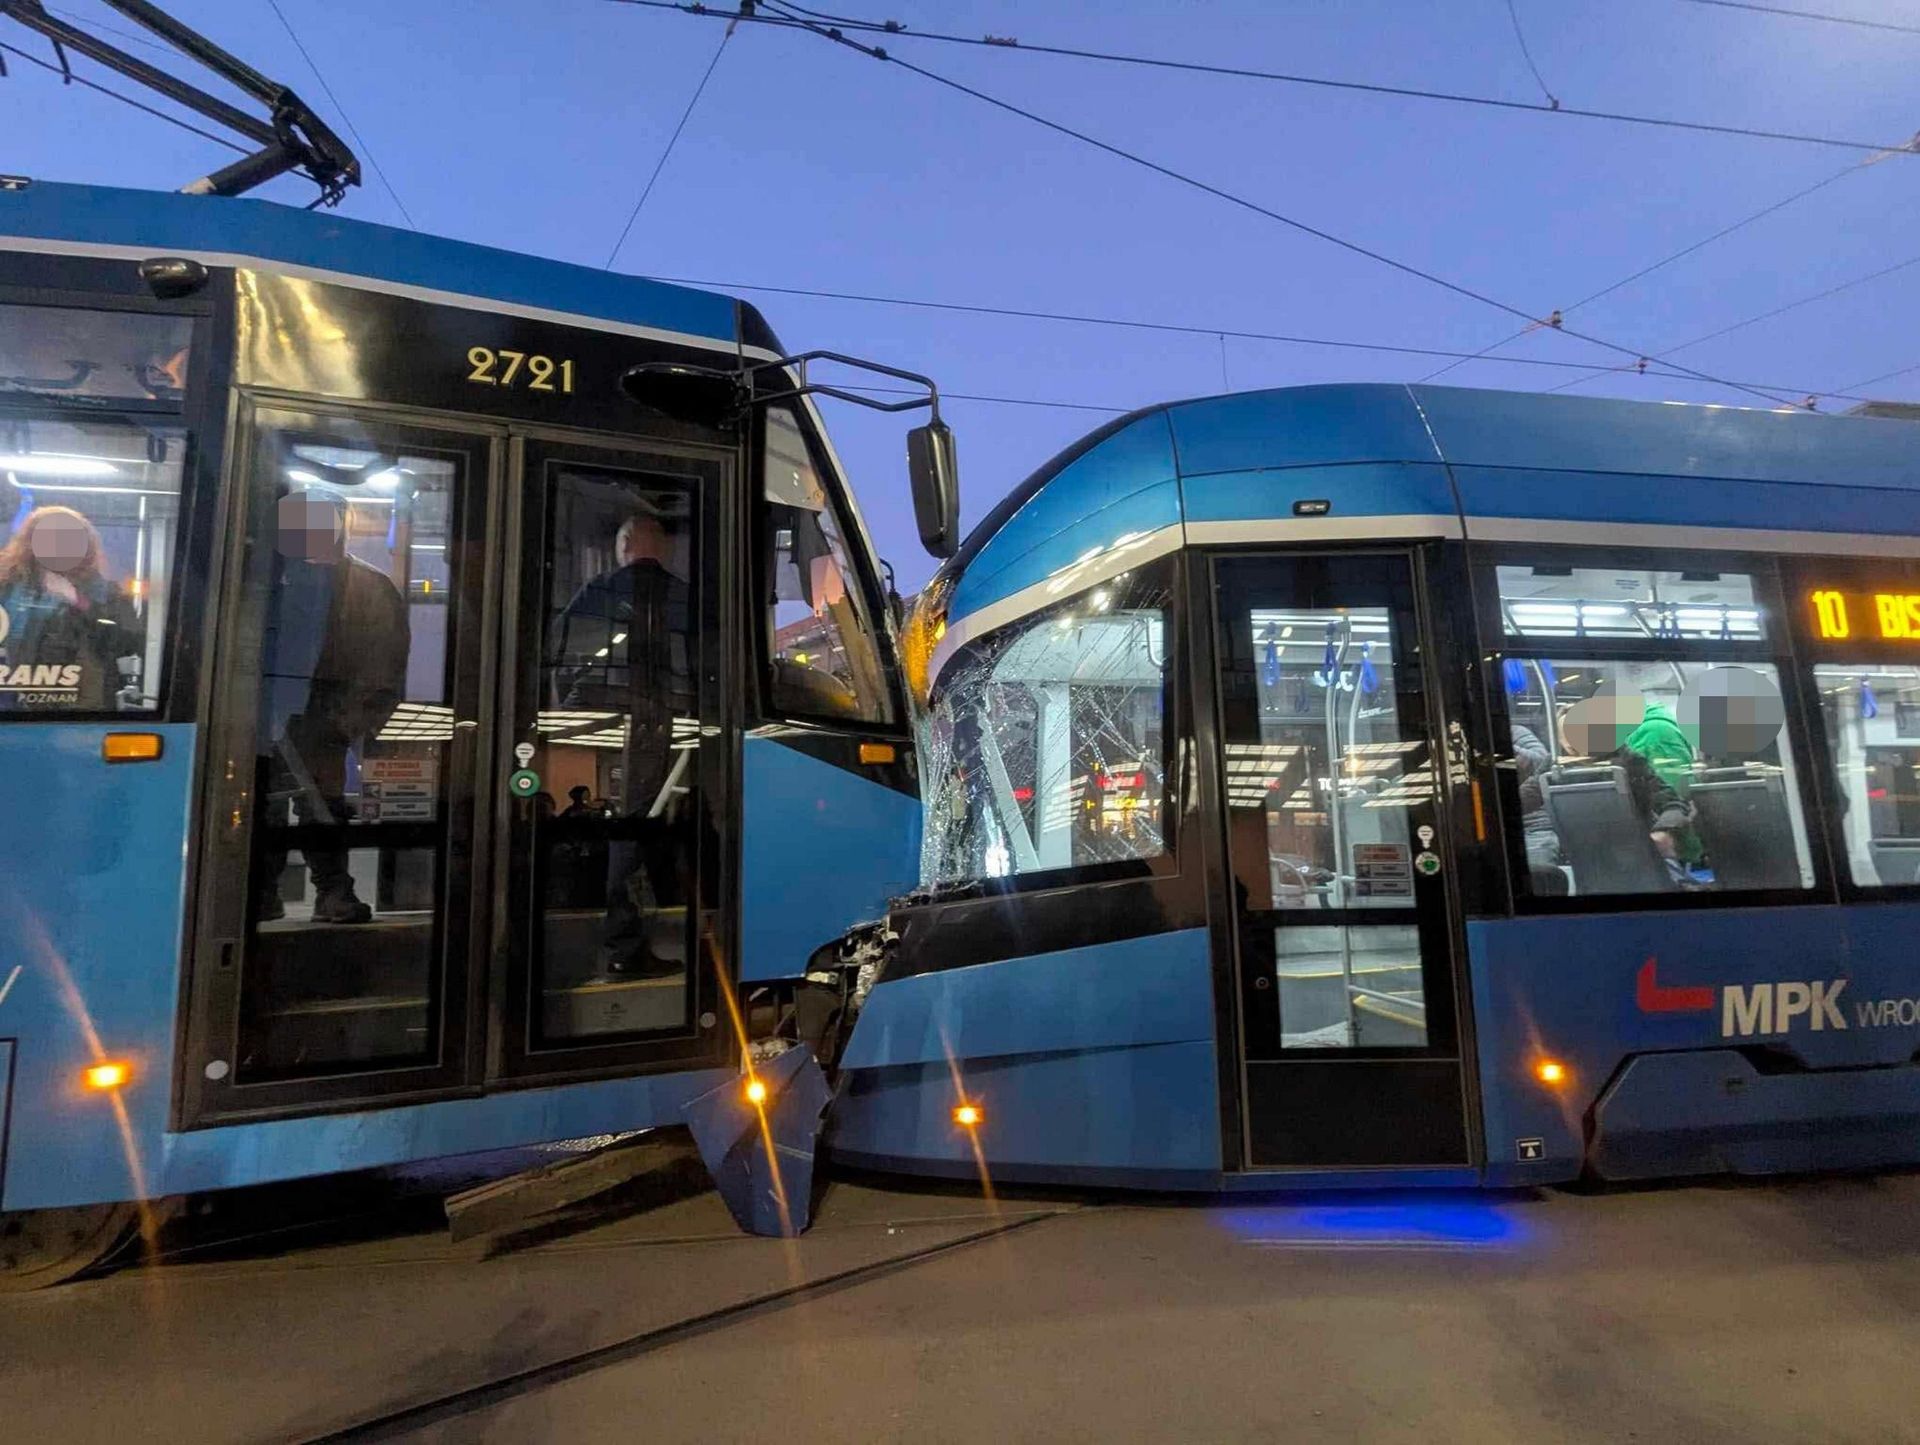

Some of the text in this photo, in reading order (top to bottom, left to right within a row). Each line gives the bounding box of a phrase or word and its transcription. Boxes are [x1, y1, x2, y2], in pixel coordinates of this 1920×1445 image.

[467, 346, 572, 392] 2721
[1812, 591, 1920, 639] 10 BIS
[1722, 979, 1847, 1037] MPK
